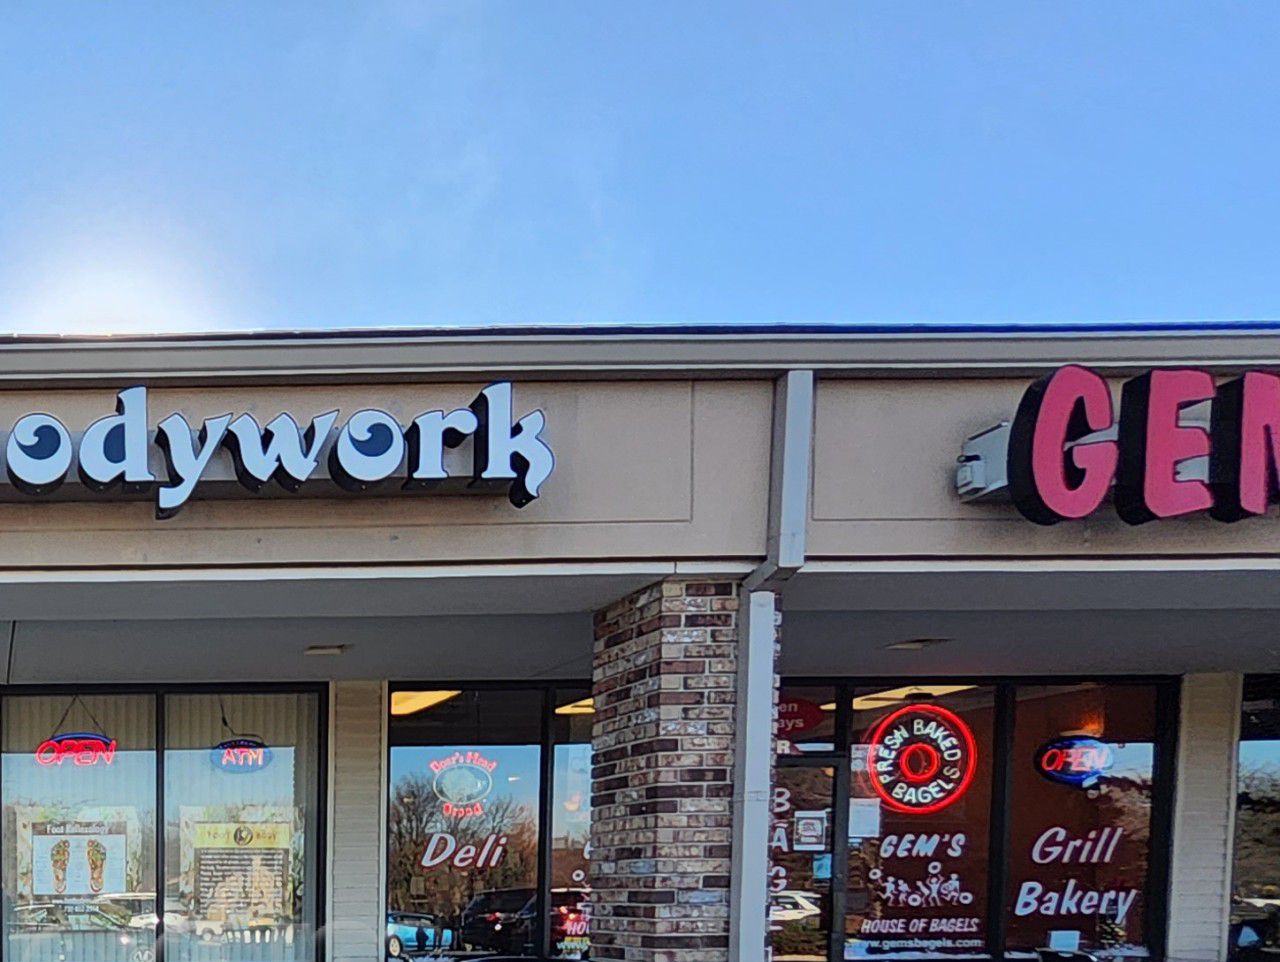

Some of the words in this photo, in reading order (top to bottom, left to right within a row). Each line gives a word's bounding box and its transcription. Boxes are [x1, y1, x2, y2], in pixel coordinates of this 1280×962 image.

[35, 738, 117, 766] OPEN
[913, 718, 962, 761] BAKED
[221, 747, 264, 767] ATM
[1041, 747, 1110, 772] OPEN
[891, 765, 961, 804] BAGELS
[421, 832, 508, 868] Deli
[880, 833, 966, 858] GEM'S
[1031, 826, 1124, 864] Grill
[1014, 878, 1139, 926] Bakery
[860, 918, 908, 934] HOUSE
[908, 918, 927, 933] OF
[928, 918, 980, 933] BAGELS
